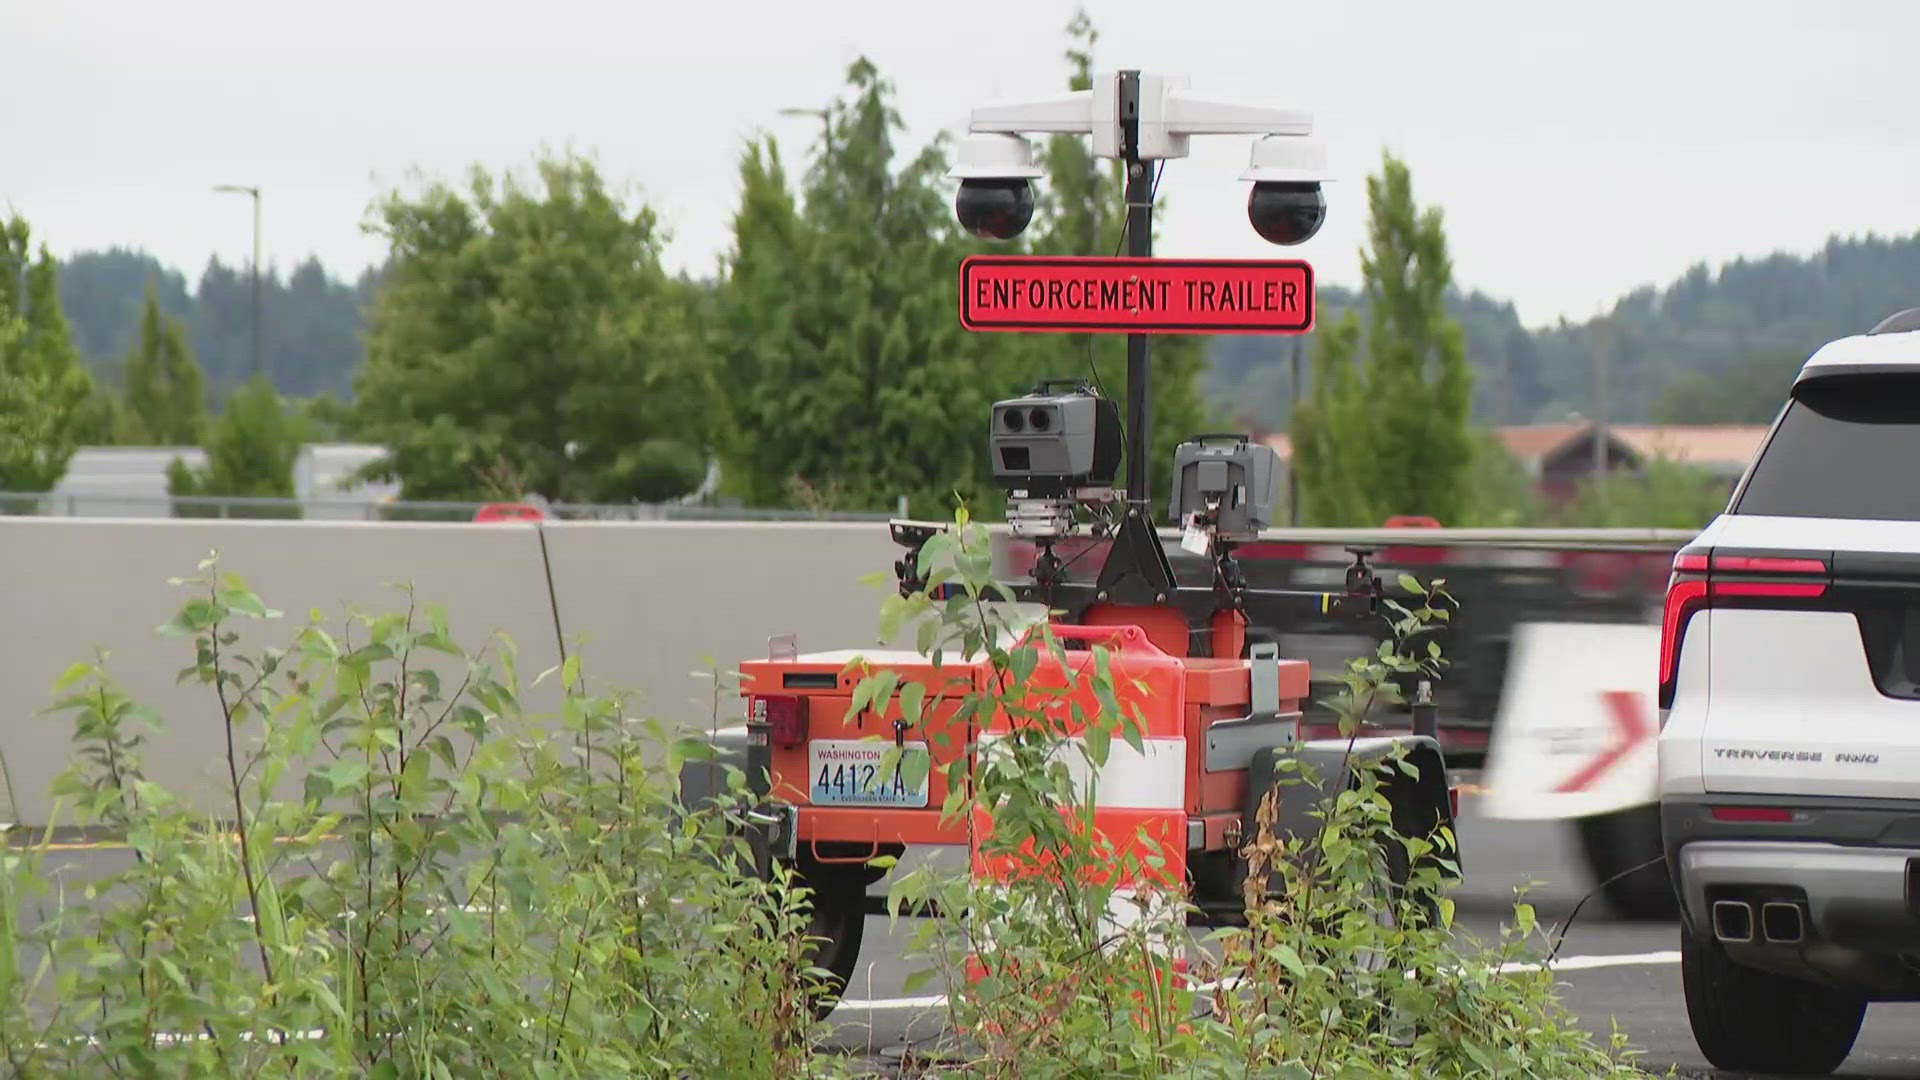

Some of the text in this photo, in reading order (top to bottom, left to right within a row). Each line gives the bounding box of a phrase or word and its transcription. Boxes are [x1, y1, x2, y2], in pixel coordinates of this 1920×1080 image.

[976, 278, 1298, 313] ENFORCEMENT TRAILER
[817, 749, 881, 760] WASHINGTON
[1713, 748, 1879, 764] TRAVERSE AWD
